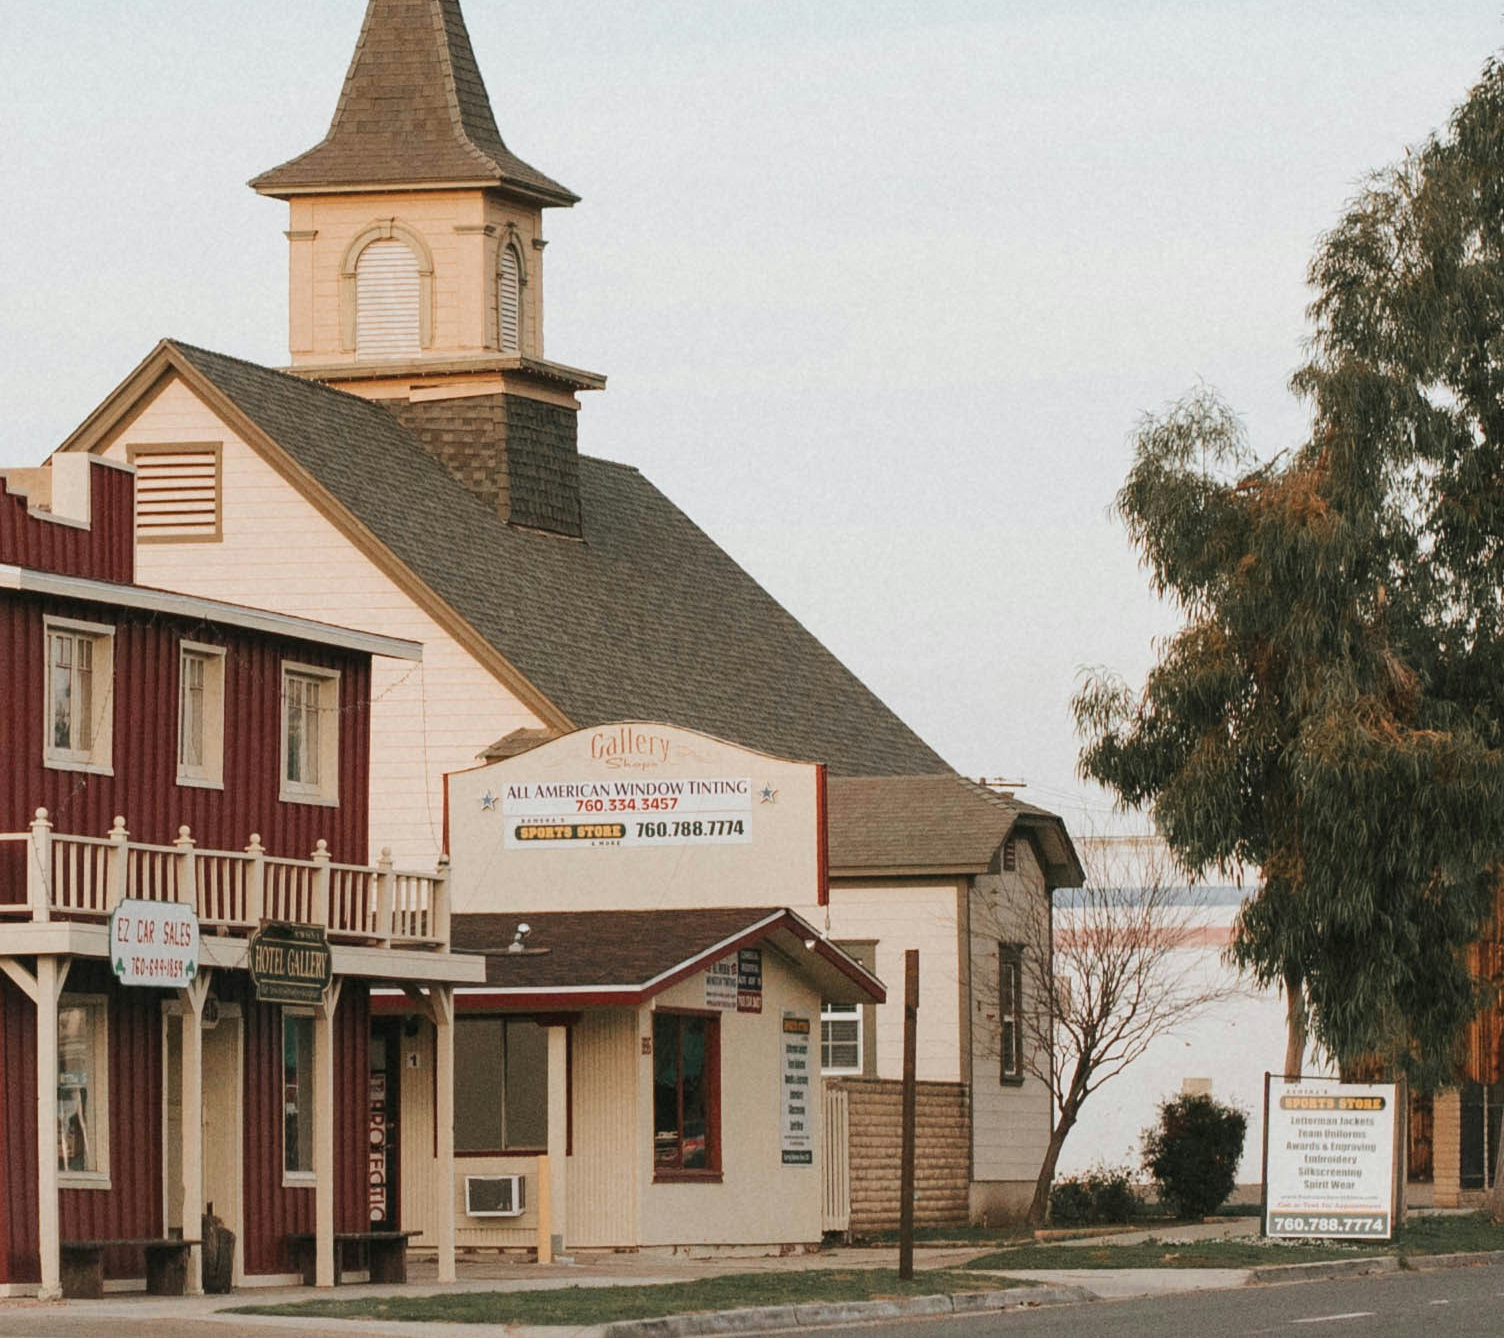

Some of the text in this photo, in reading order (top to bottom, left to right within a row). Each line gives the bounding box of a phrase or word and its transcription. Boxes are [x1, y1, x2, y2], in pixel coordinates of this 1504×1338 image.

[591, 728, 670, 762] Gallery
[506, 780, 748, 799] ALL AMERICAN WINDOW TINTING
[575, 798, 679, 812] 760.334.3457
[520, 824, 622, 839] SPORTS STORE
[635, 819, 745, 839] 760.788.7774
[117, 916, 191, 948] EZ CAR SALES
[255, 945, 329, 979] HOTEL GALLERY
[1284, 1097, 1382, 1110] SPORTS STORE
[1290, 1116, 1374, 1126] Letterman Jackets
[1298, 1129, 1366, 1138] Team Uniforms
[1286, 1141, 1320, 1150] Awards
[1330, 1142, 1376, 1152] Engraving
[1304, 1155, 1358, 1164] Embroidery
[1298, 1167, 1362, 1178] Silkscreening
[1304, 1180, 1356, 1190] Spirit Wear
[1273, 1217, 1384, 1232] 760.788.7774
